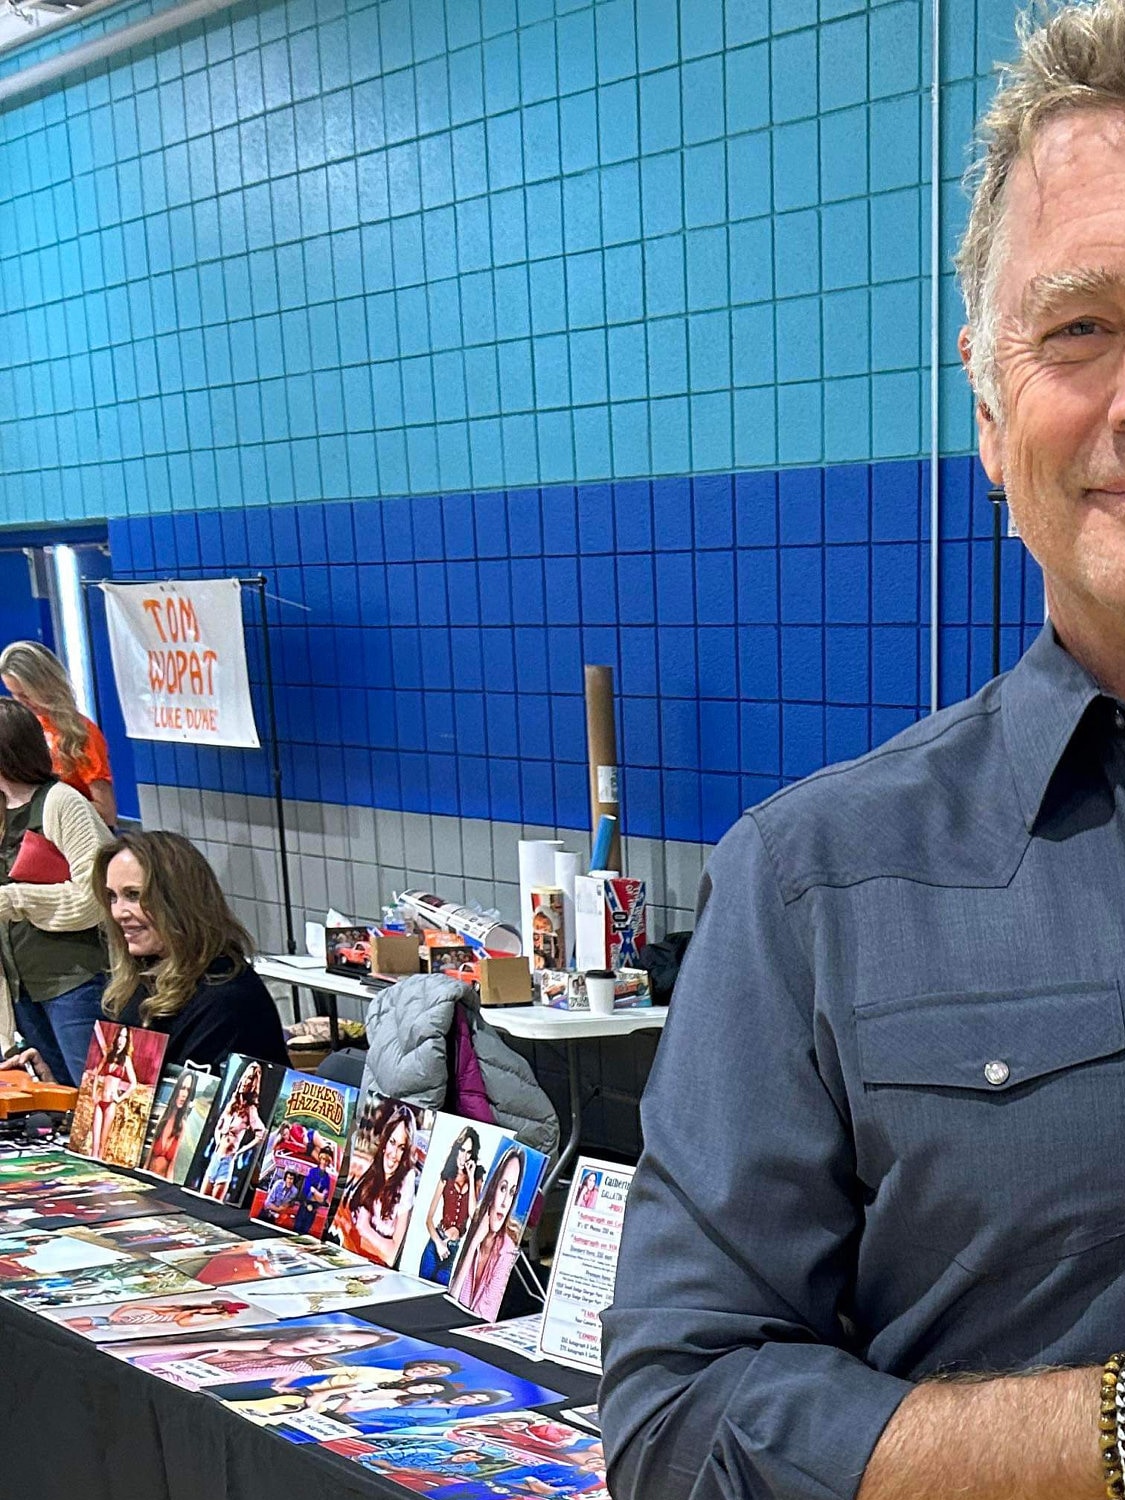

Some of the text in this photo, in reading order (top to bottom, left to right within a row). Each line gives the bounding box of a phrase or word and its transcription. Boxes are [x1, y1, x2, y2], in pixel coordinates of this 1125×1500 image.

[143, 597, 201, 643] TOM
[148, 649, 218, 696] WOPAT
[286, 1092, 344, 1126] HAZZARD
[302, 1082, 338, 1104] DUKES
